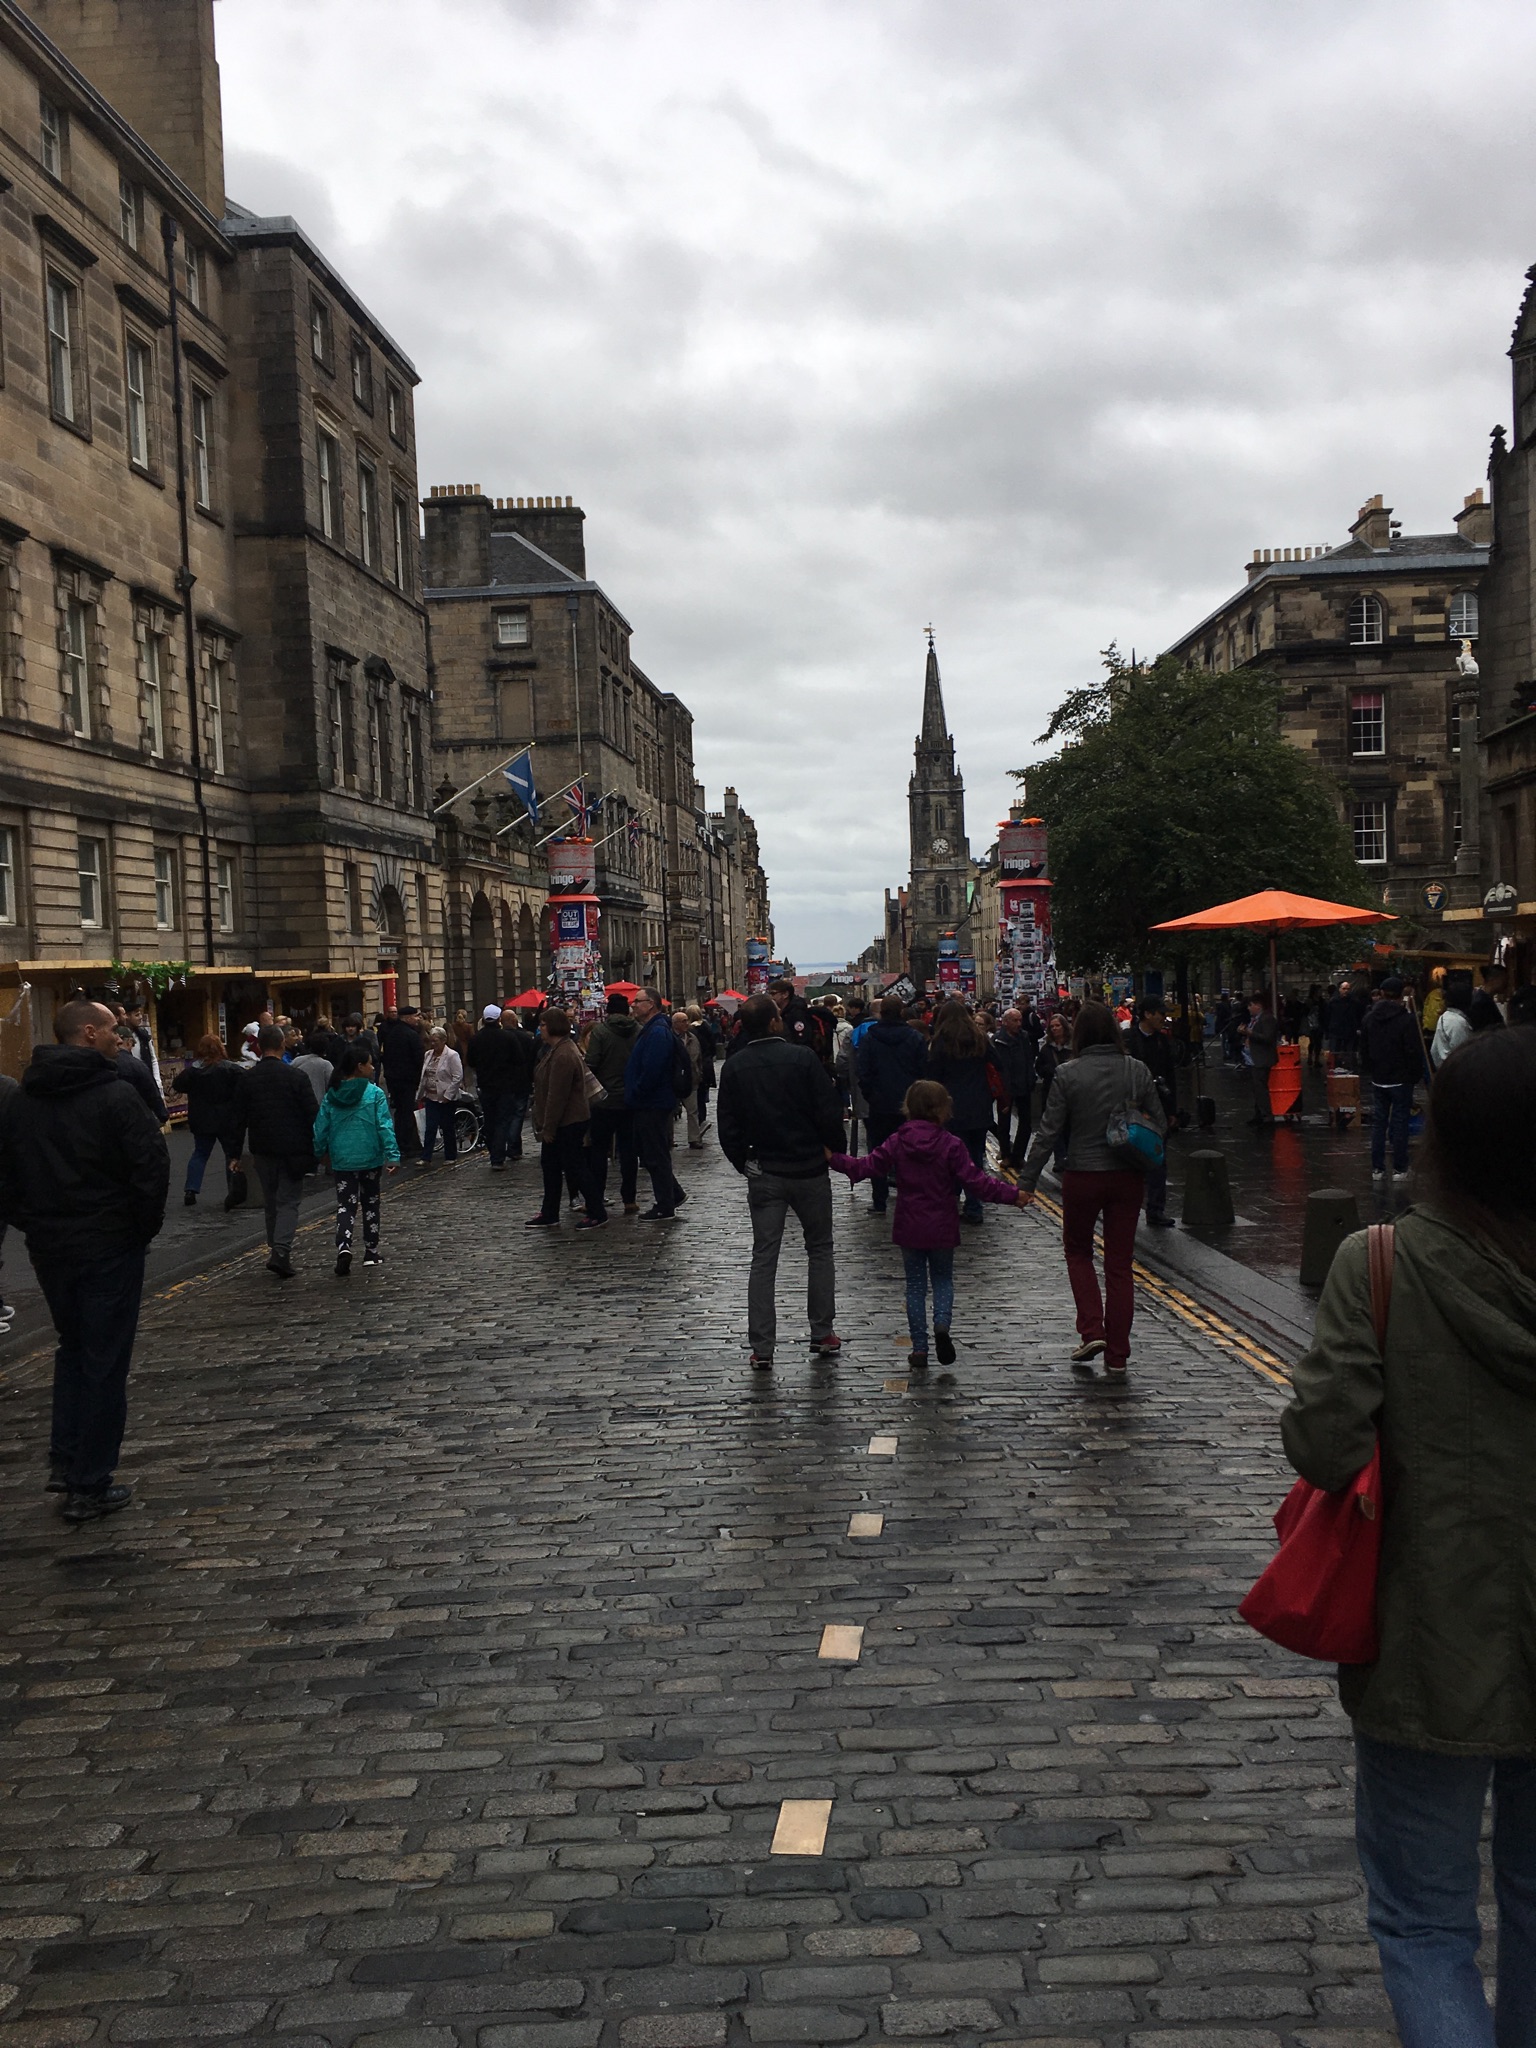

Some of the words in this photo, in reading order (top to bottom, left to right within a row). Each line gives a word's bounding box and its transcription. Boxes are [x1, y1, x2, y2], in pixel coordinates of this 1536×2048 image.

[1004, 858, 1030, 870] fringe
[551, 874, 574, 885] fringe
[831, 974, 854, 984] fringe
